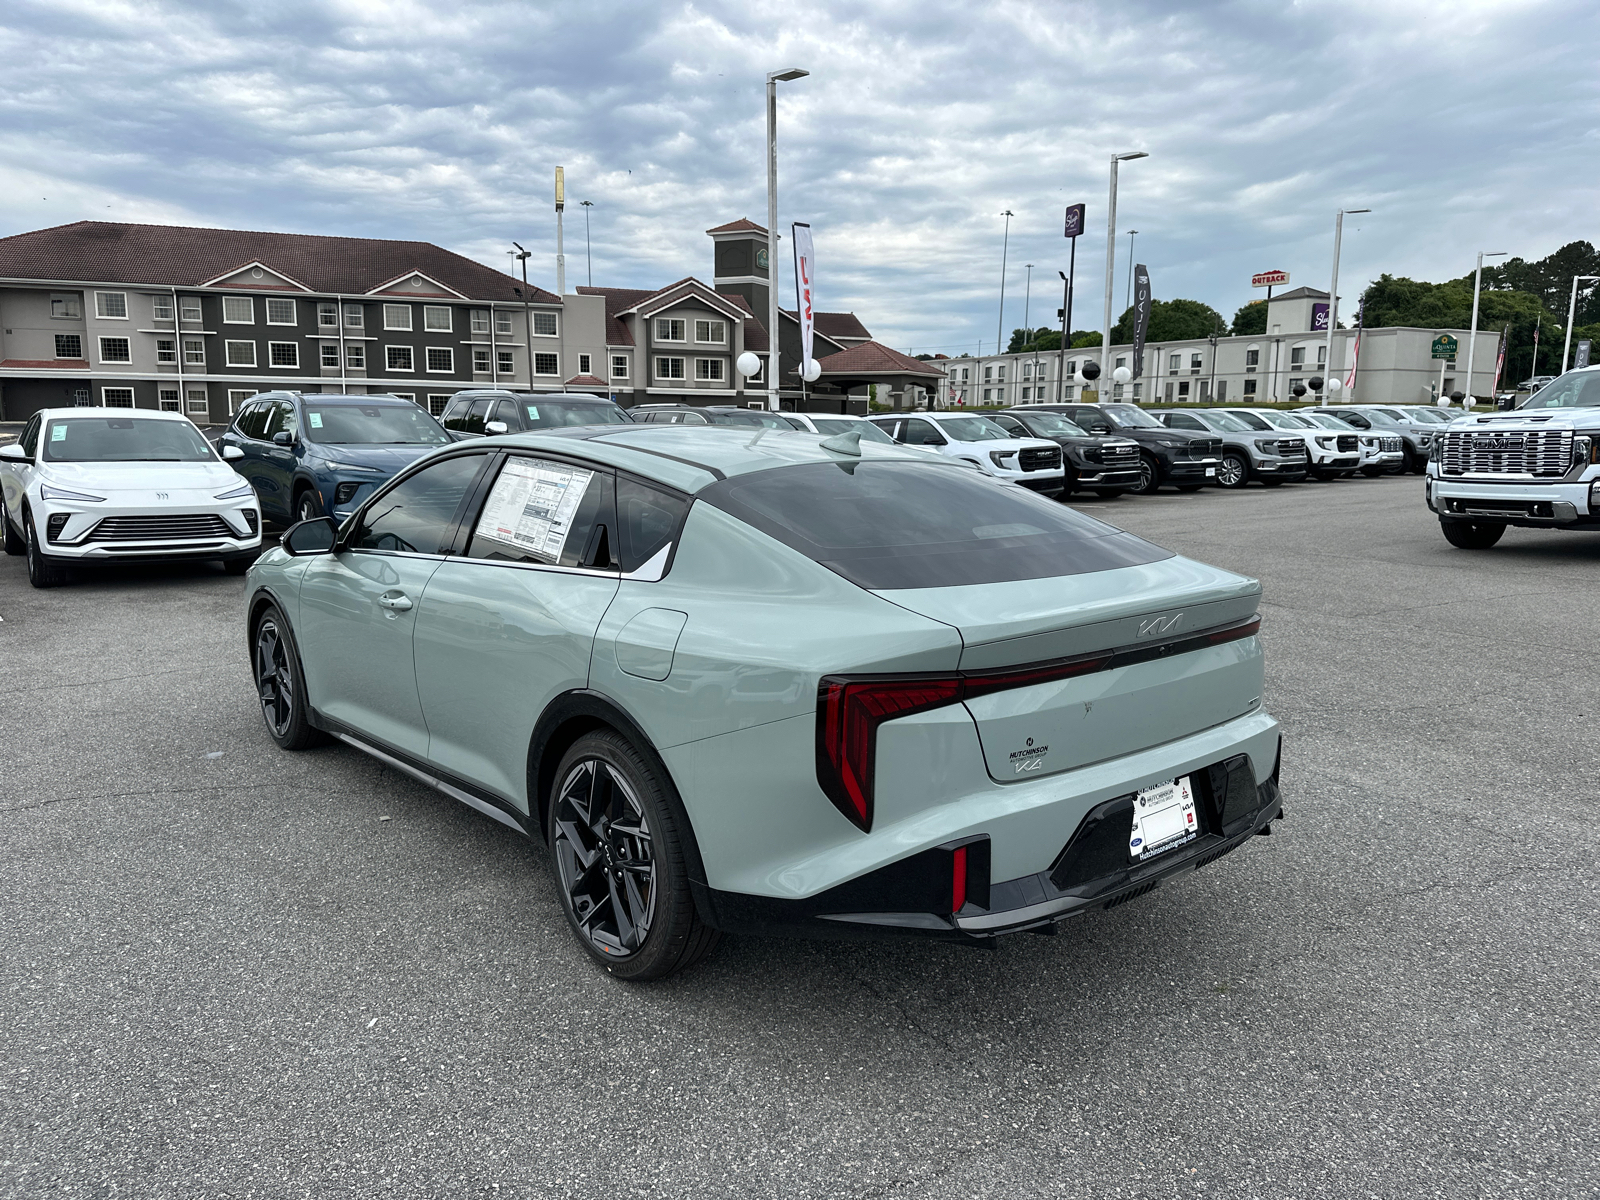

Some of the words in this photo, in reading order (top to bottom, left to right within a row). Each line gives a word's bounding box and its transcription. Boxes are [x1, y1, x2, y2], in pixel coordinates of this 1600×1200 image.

[1252, 275, 1286, 285] OUTBACK
[1474, 438, 1523, 450] GMC
[1136, 612, 1184, 638] KIA
[1009, 745, 1049, 759] HUTCHINSON
[612, 958, 645, 973] KUMHO
